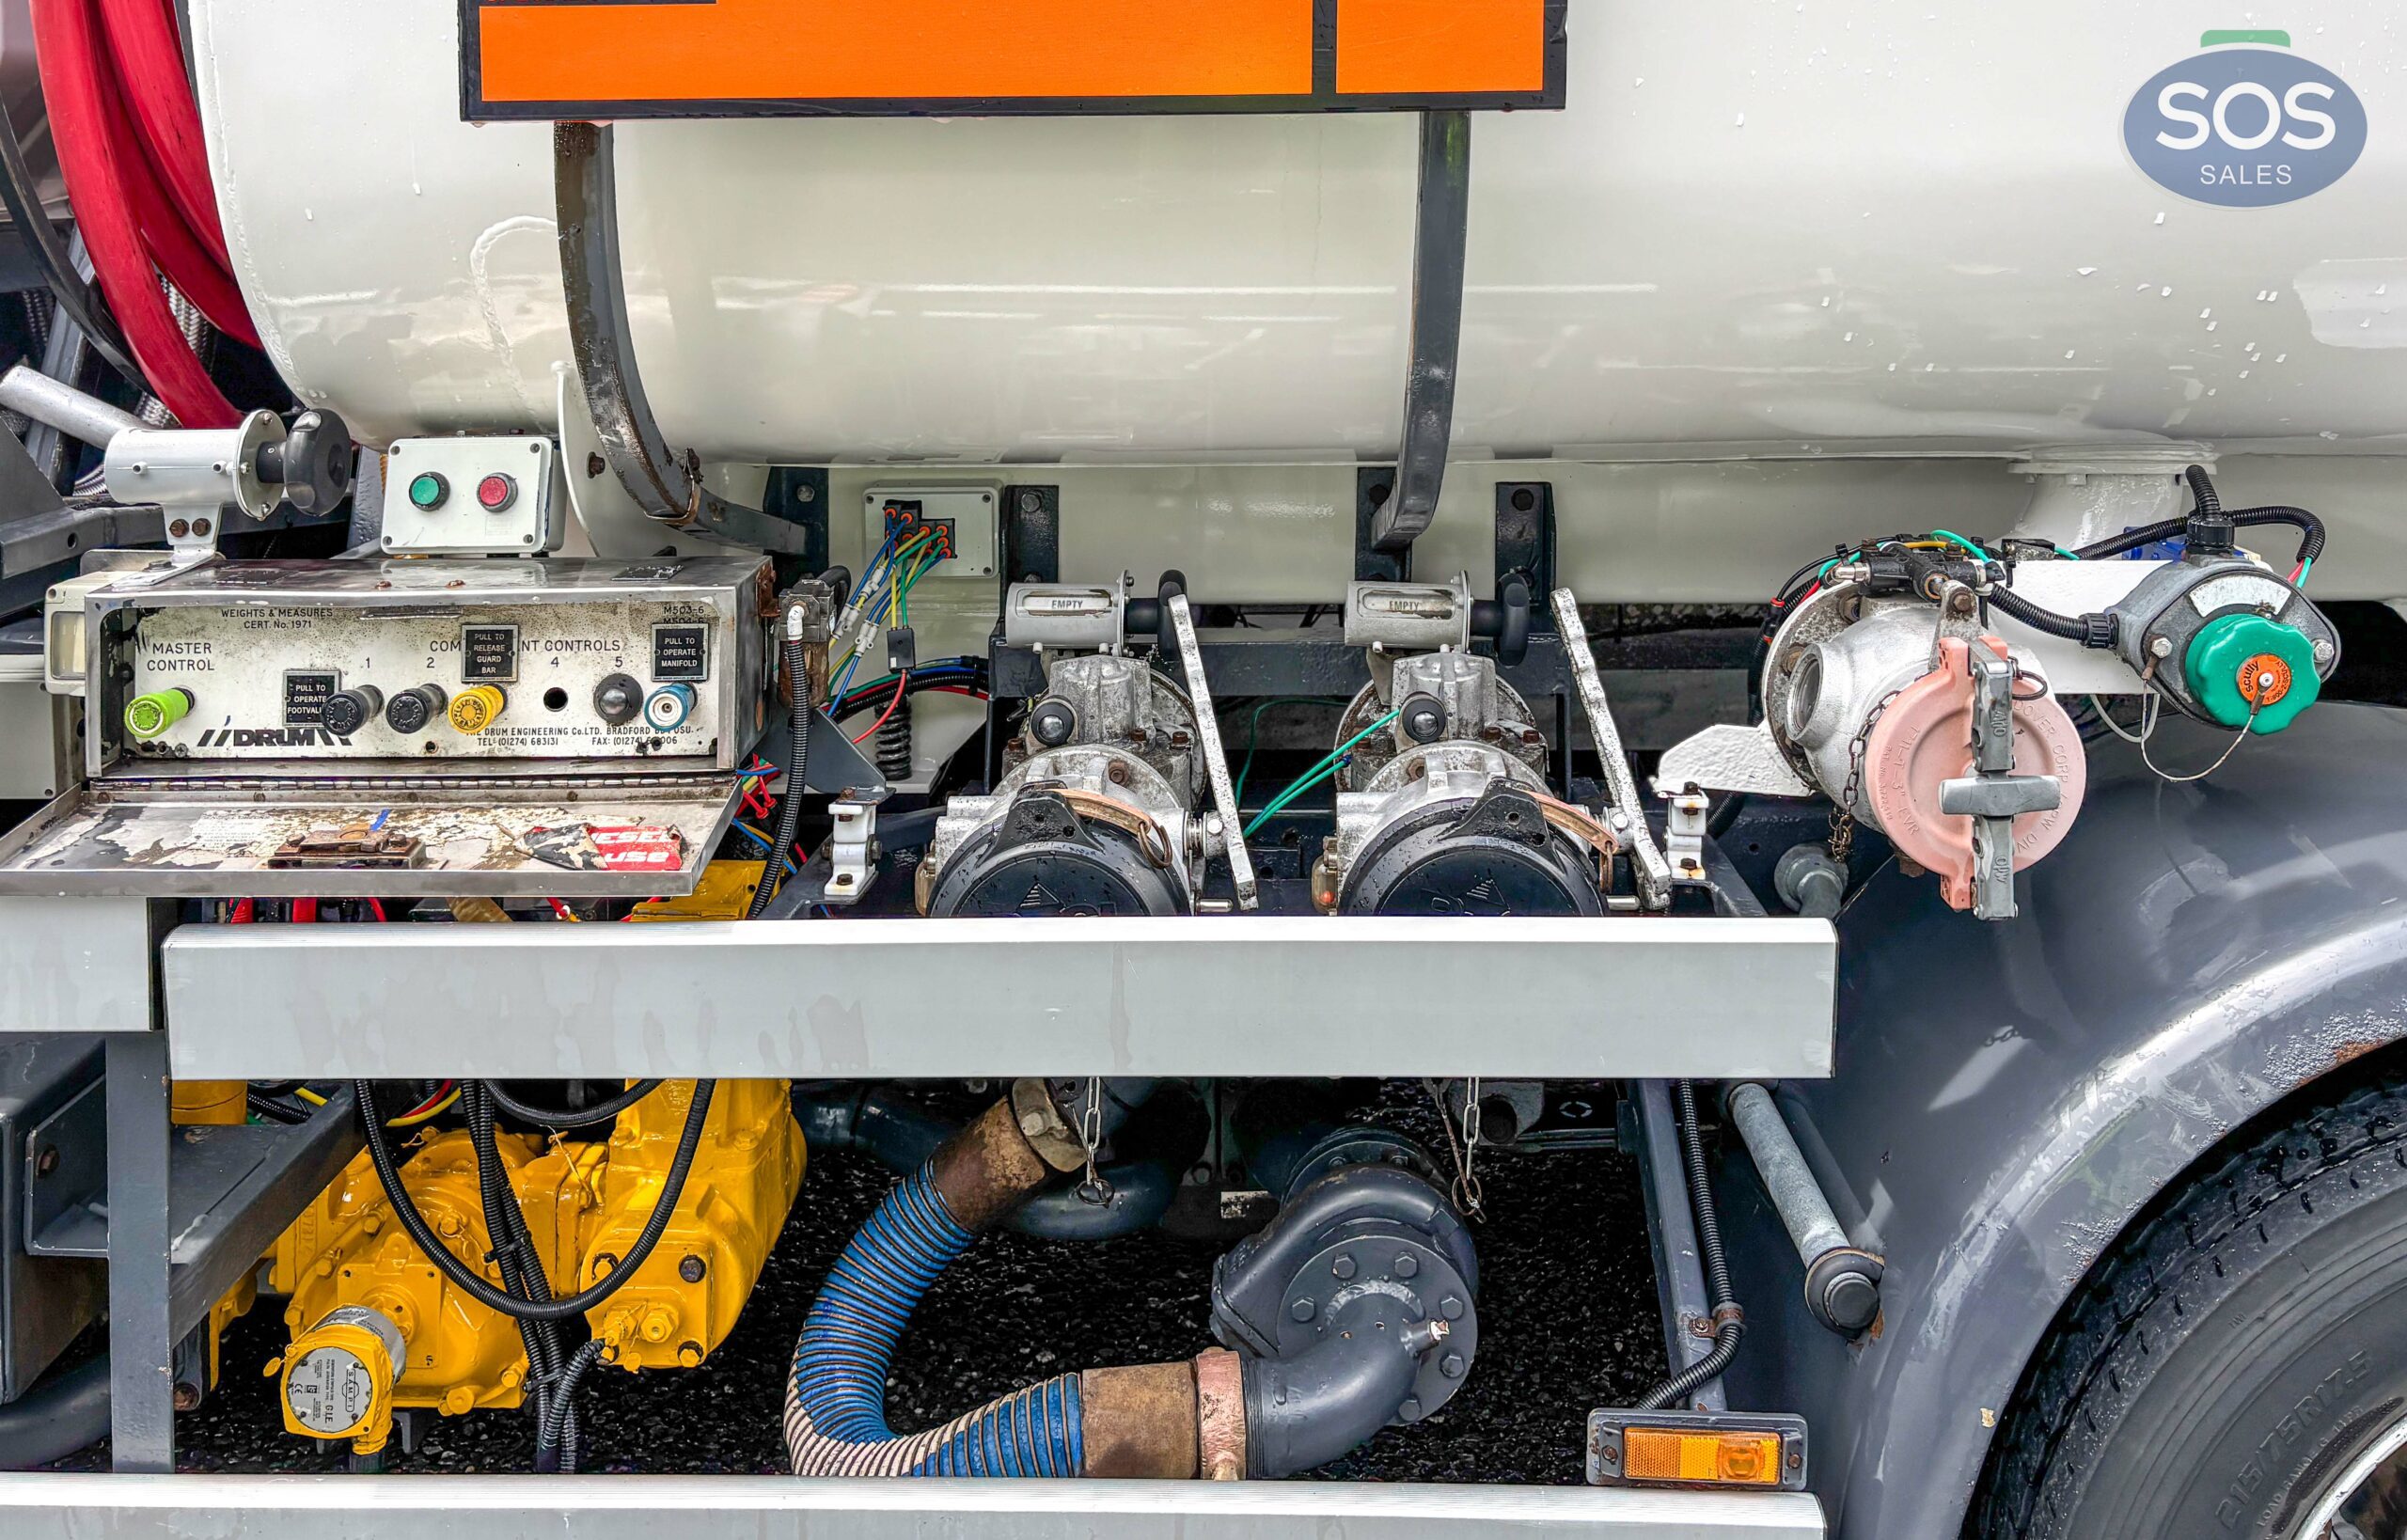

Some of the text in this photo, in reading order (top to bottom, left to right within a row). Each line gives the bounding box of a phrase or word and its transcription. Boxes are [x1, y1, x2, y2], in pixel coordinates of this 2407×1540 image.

[663, 605, 705, 615] M503-6
[1051, 599, 1083, 609] EMPTY
[1389, 600, 1420, 611] EMPTY
[221, 607, 333, 619] WEIGHTS & MEASURES
[244, 621, 271, 630] CERT.
[291, 621, 312, 629] 1971
[152, 643, 212, 654] MASTER
[474, 644, 506, 652] RELEASE
[544, 639, 621, 652] CONTROLS
[147, 660, 215, 672] CONTROL
[365, 657, 370, 669] 1
[427, 656, 435, 668] 2
[551, 656, 559, 668] 4
[615, 656, 623, 668] 5
[481, 666, 496, 674] BAR
[2243, 660, 2259, 692] scully
[2013, 699, 2055, 739] DOVER
[485, 728, 508, 736] DRUM
[606, 726, 651, 734] BRADFORD
[231, 730, 316, 746] DRUM
[530, 737, 558, 746] 683131
[2052, 744, 2069, 784] CORP
[2016, 833, 2038, 855] DIV
[347, 1371, 355, 1408] SAMPI
[2257, 1492, 2284, 1527] LOAD
